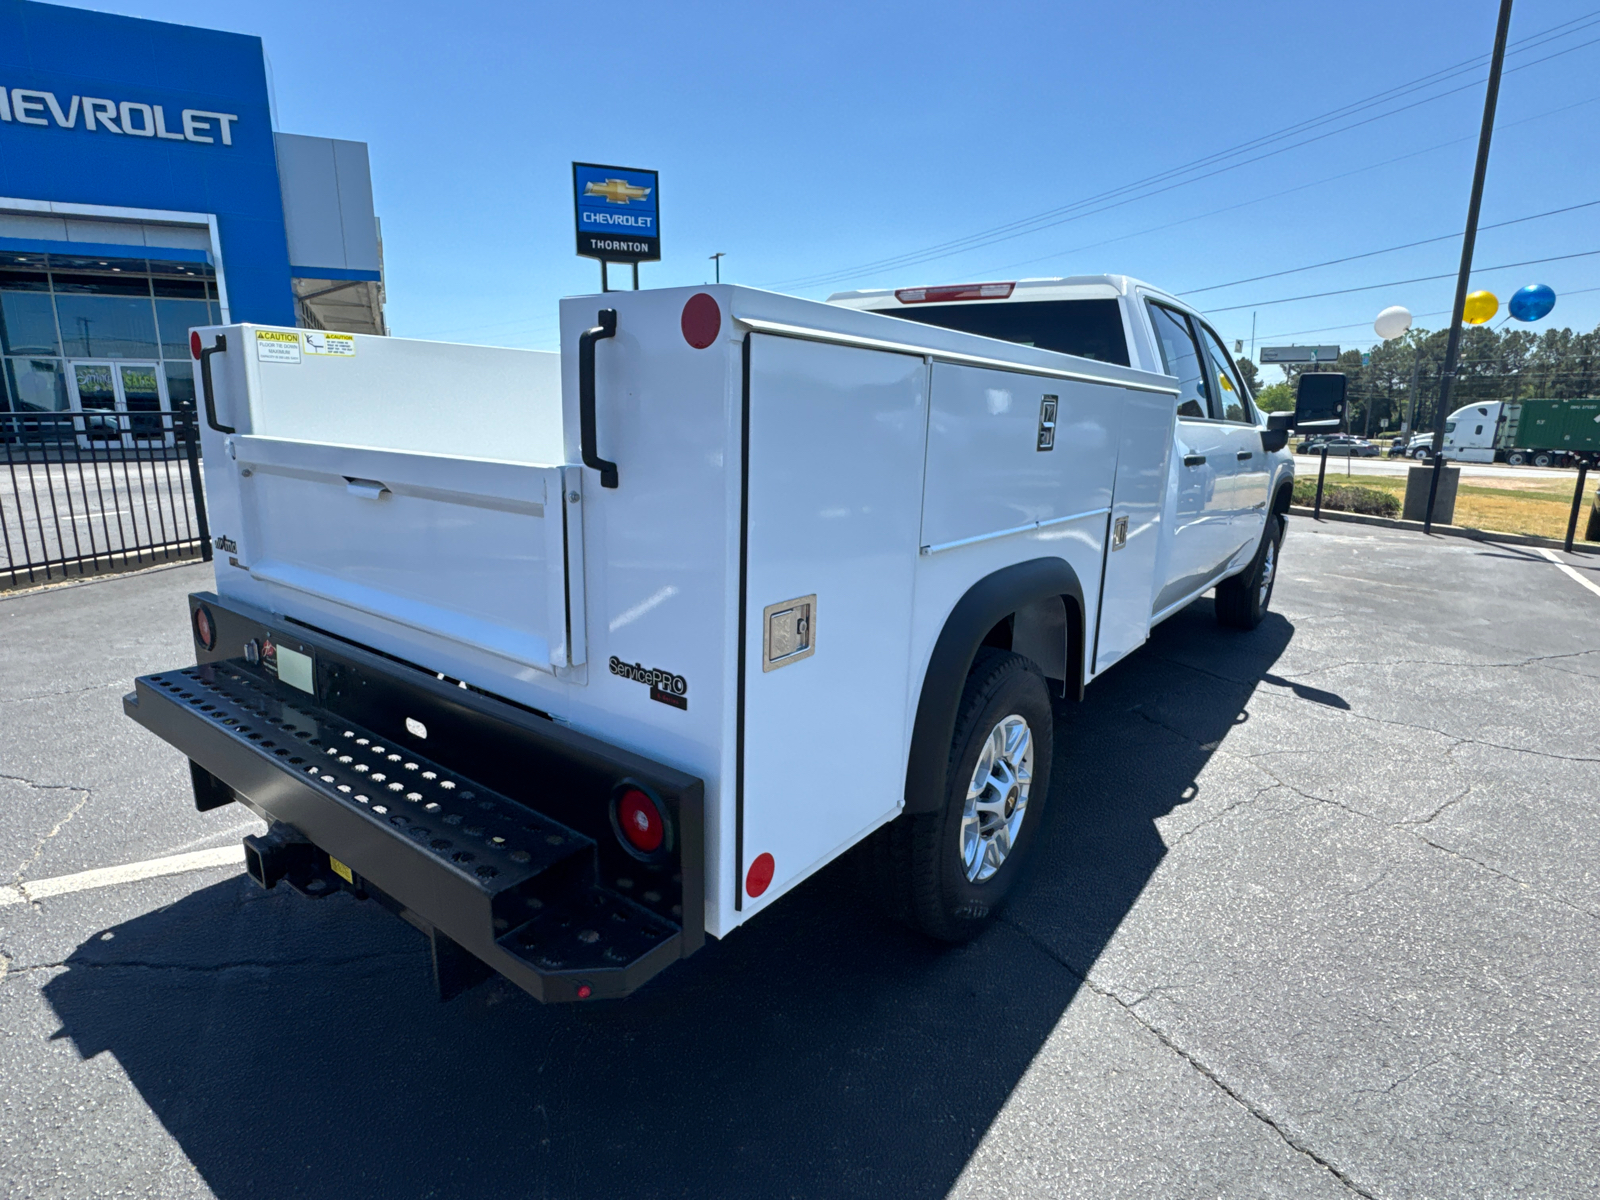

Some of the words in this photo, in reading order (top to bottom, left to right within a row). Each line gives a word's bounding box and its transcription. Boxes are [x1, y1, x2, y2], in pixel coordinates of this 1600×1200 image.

[583, 212, 652, 227] CHEVROLET
[590, 239, 649, 252] THORNTON
[264, 332, 298, 342] CAUTION
[608, 656, 687, 695] ServicePRO
